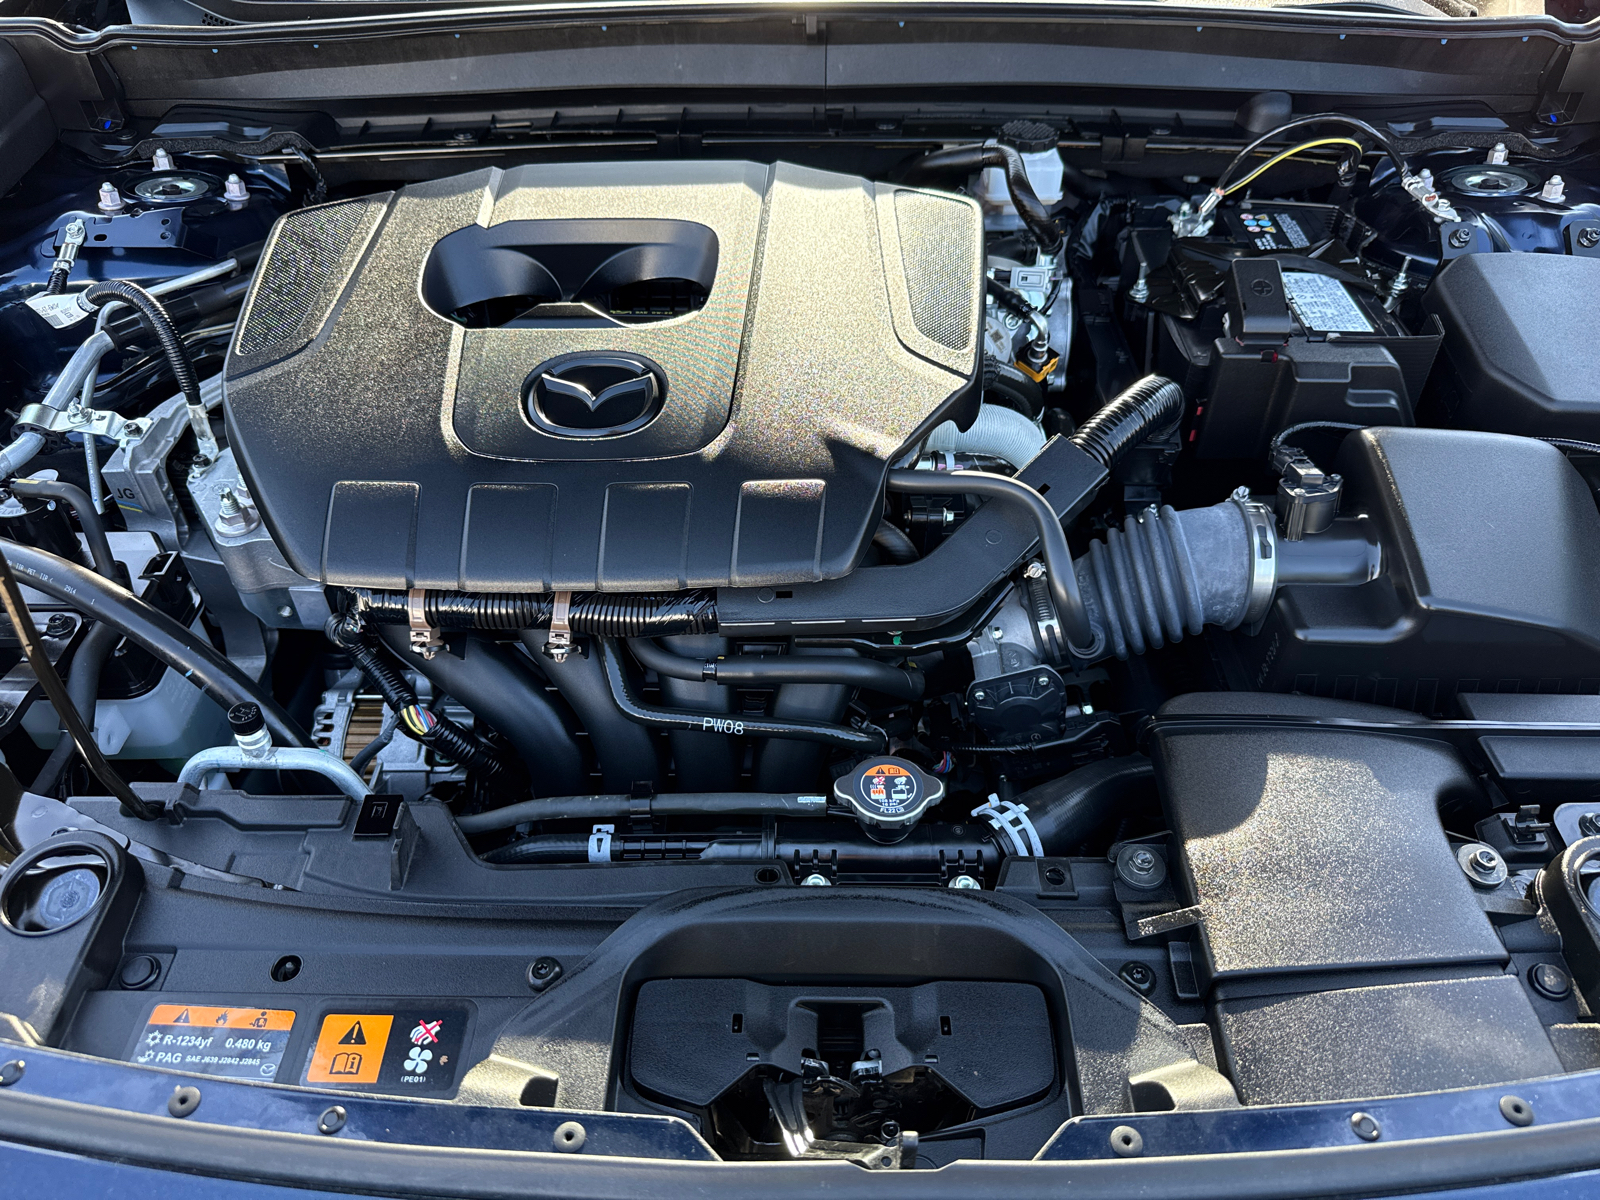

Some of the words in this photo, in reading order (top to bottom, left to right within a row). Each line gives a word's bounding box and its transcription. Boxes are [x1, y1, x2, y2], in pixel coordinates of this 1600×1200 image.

[117, 488, 136, 500] JG
[702, 717, 744, 735] PW08
[162, 1034, 214, 1050] R-1234yf
[225, 1037, 256, 1050] 0.480
[256, 1039, 272, 1052] kg
[155, 1051, 182, 1063] PAG
[185, 1054, 202, 1062] SAE
[201, 1055, 219, 1063] J639
[218, 1056, 240, 1065] J2842
[400, 1075, 427, 1083] (PE01)
